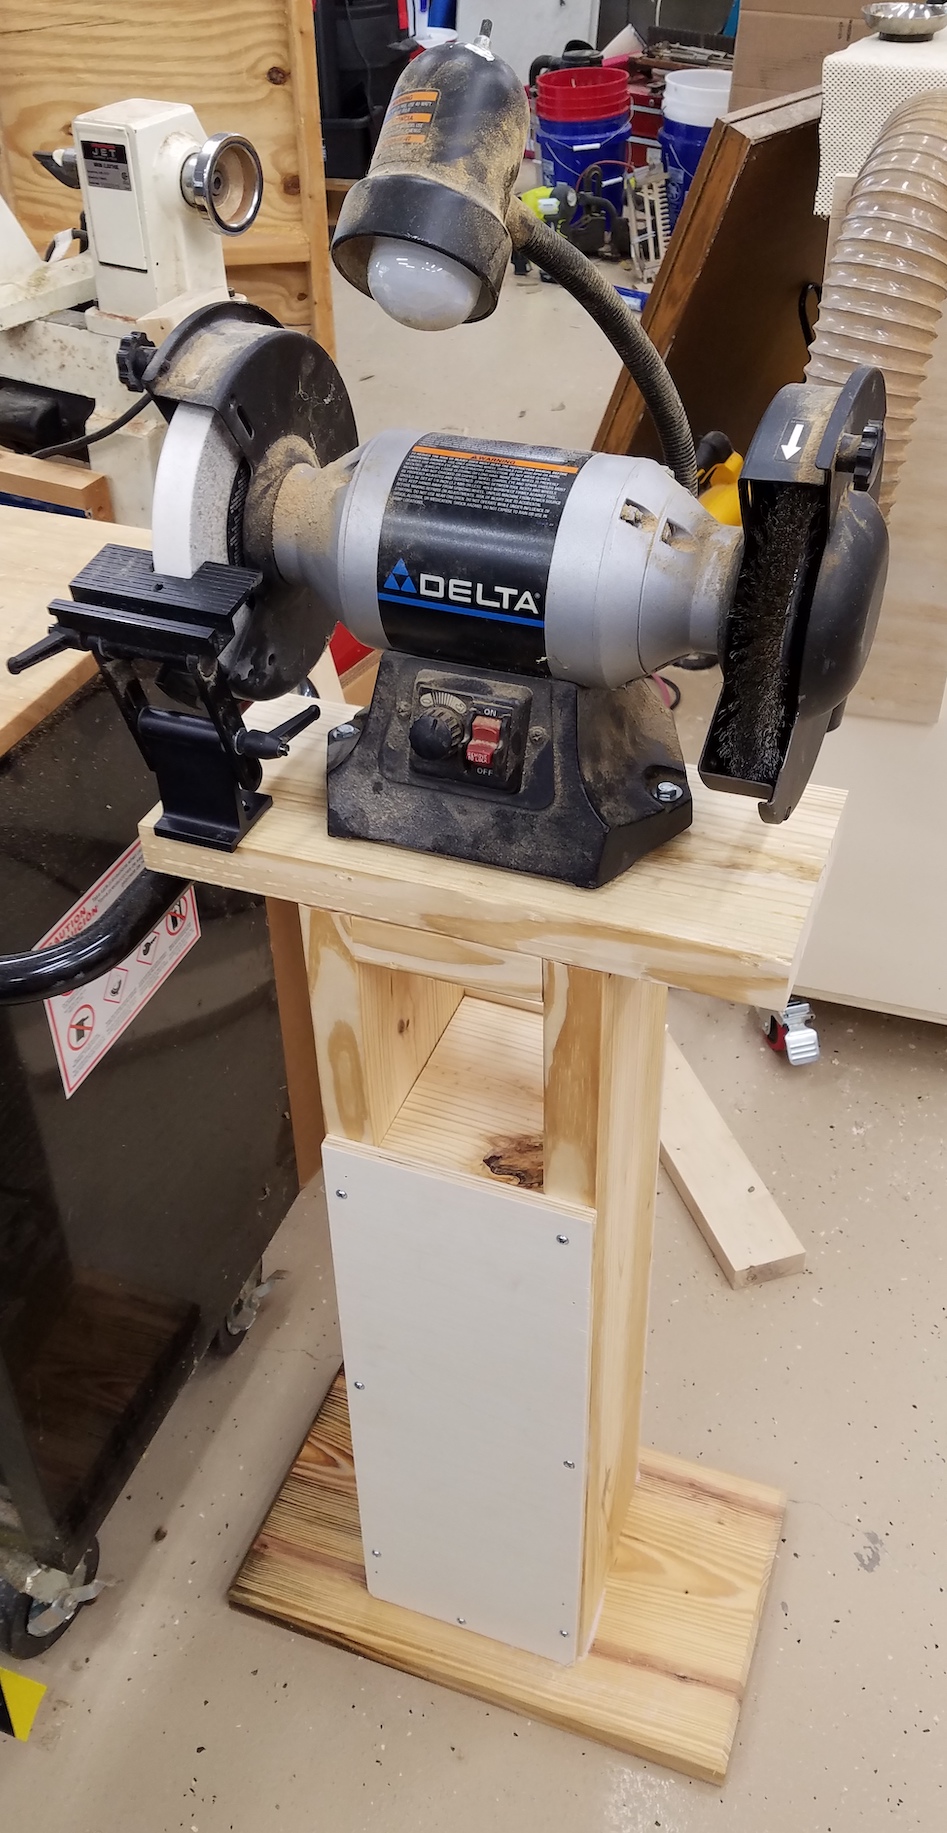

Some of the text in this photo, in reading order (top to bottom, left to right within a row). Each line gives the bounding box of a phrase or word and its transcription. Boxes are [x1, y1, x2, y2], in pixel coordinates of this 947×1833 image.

[91, 147, 116, 157] JET
[478, 456, 516, 465] WARNING
[419, 572, 540, 615] DELTA
[484, 708, 497, 717] ON
[476, 767, 494, 776] OFF
